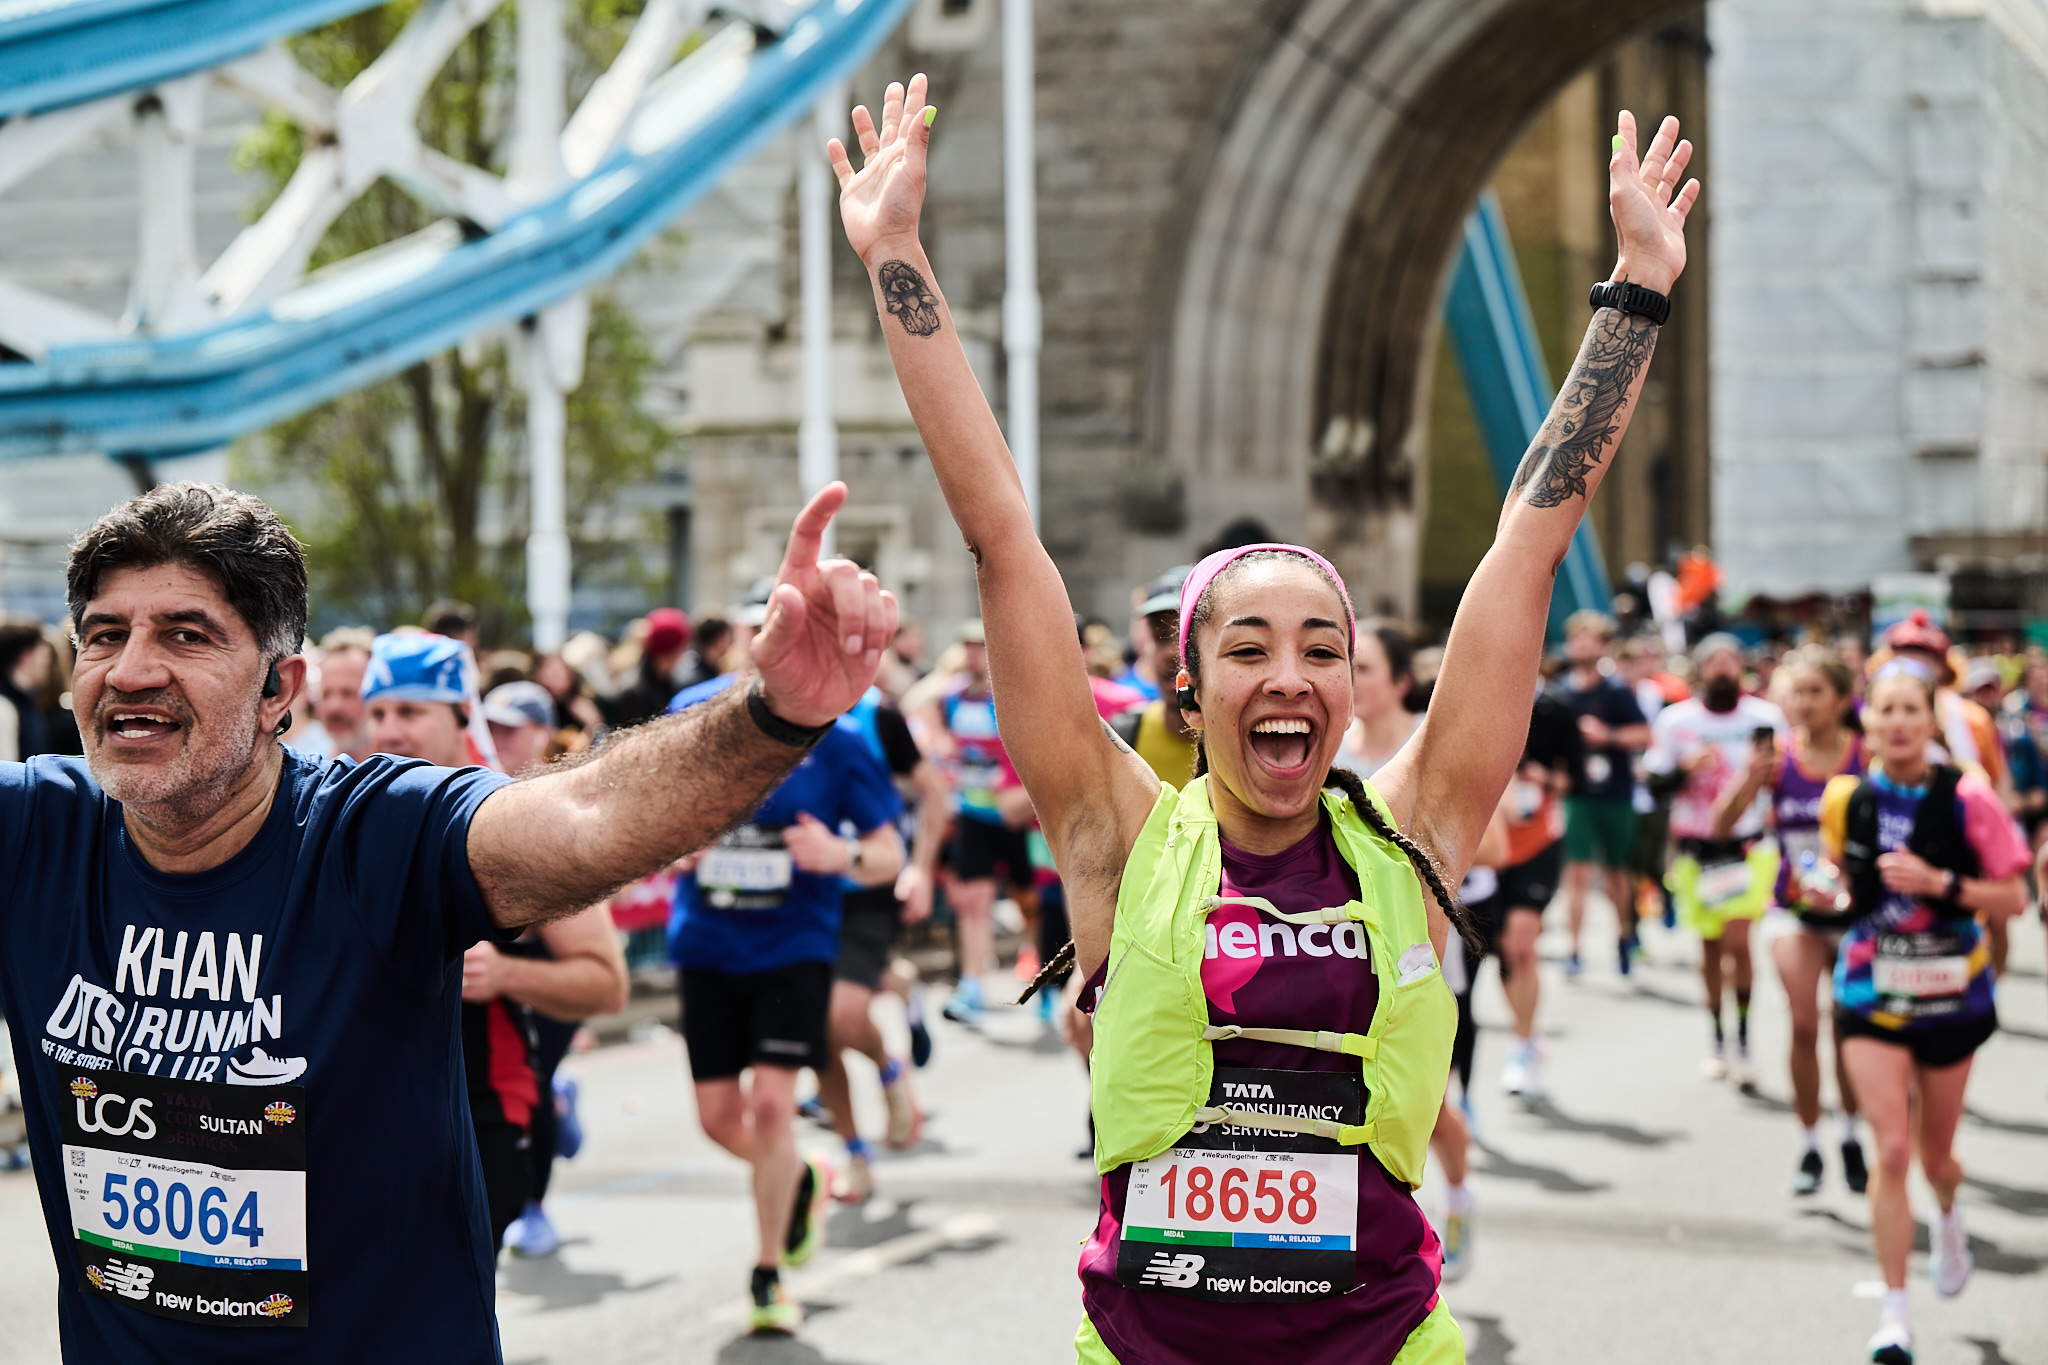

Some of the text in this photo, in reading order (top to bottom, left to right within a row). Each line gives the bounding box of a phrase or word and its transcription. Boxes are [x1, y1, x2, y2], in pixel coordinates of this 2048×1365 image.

[1204, 921, 1378, 975] enca
[115, 924, 263, 1003] KHAN
[41, 1038, 114, 1071] OFF THE STREET
[1222, 1082, 1275, 1099] TATA
[267, 1107, 292, 1117] LONDON
[269, 1114, 289, 1122] 2024
[199, 1115, 263, 1135] SULTAN
[1201, 1152, 1258, 1161] #WeRunTogether
[148, 1163, 203, 1176] #WeRunTogether
[1160, 1164, 1317, 1225] 18658
[102, 1172, 264, 1247] 58064
[1163, 1229, 1321, 1244] MEDAL SMA, RELAXED
[112, 1239, 268, 1267] MEDAL LAR, RELAXED
[1206, 1277, 1247, 1293] new
[1250, 1275, 1332, 1294] balance
[155, 1291, 193, 1311] new
[197, 1295, 270, 1317] balanc
[264, 1298, 289, 1311] LONDON
[268, 1306, 288, 1317] 2024
